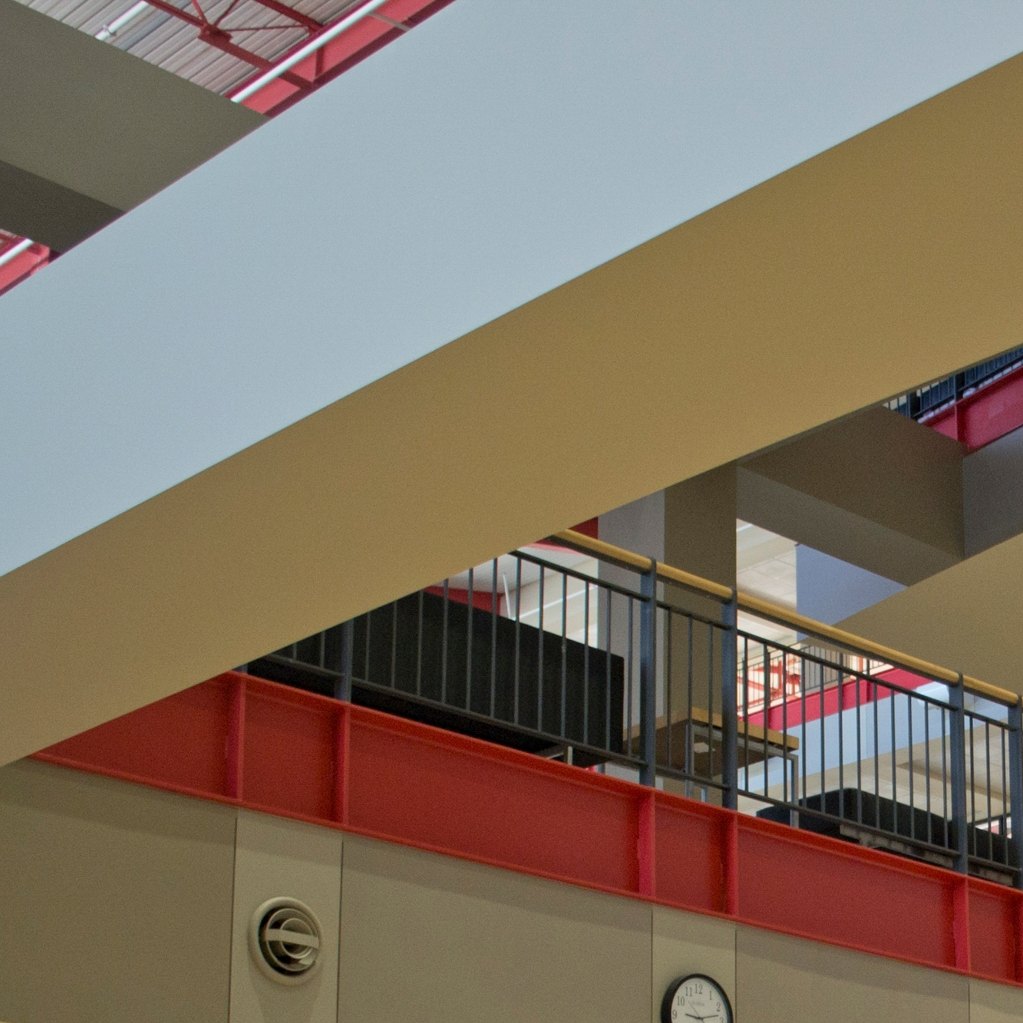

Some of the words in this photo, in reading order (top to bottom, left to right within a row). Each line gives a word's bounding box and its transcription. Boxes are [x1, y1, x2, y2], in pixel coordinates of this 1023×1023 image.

[685, 986, 693, 997] 11
[694, 983, 703, 995] 12
[676, 995, 685, 1006] 10
[709, 990, 713, 1001] 1
[716, 1001, 721, 1012] 2
[672, 1009, 678, 1019] 9
